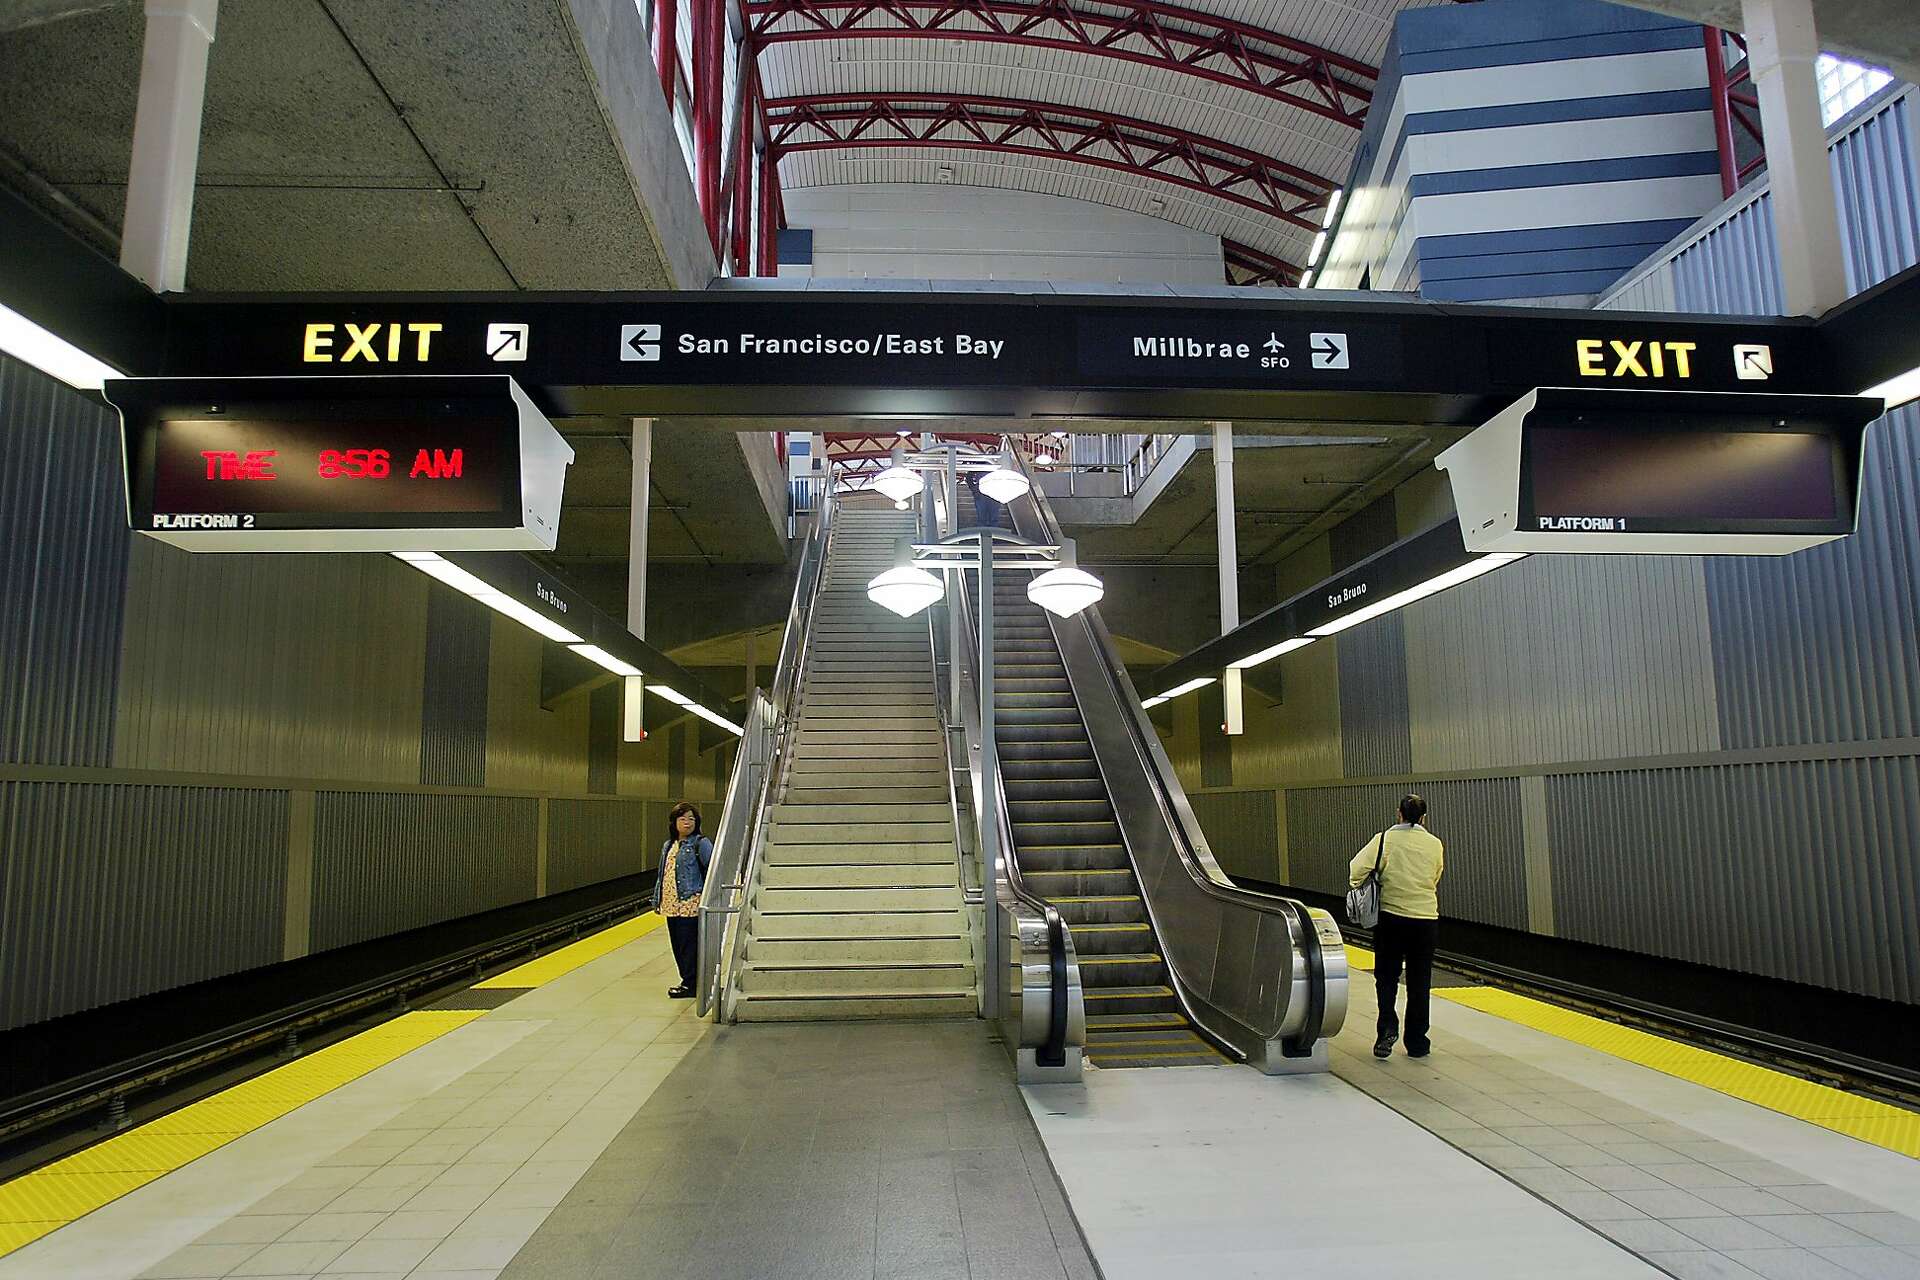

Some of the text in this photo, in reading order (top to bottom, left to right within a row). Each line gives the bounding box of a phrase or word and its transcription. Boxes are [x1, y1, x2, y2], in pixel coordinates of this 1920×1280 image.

[303, 323, 443, 363] EXIT
[678, 333, 1005, 360] San Francisco/East Bay
[1133, 336, 1250, 358] Millbrae
[1260, 356, 1290, 368] SFO
[1576, 339, 1697, 378] EXIT
[200, 449, 279, 481] TIME
[408, 448, 463, 479] AM
[152, 514, 255, 528] PLATFORM 2
[1539, 517, 1626, 531] PLATFORM 1
[536, 582, 568, 613] San Bruno
[1327, 583, 1367, 608] San Bruno
